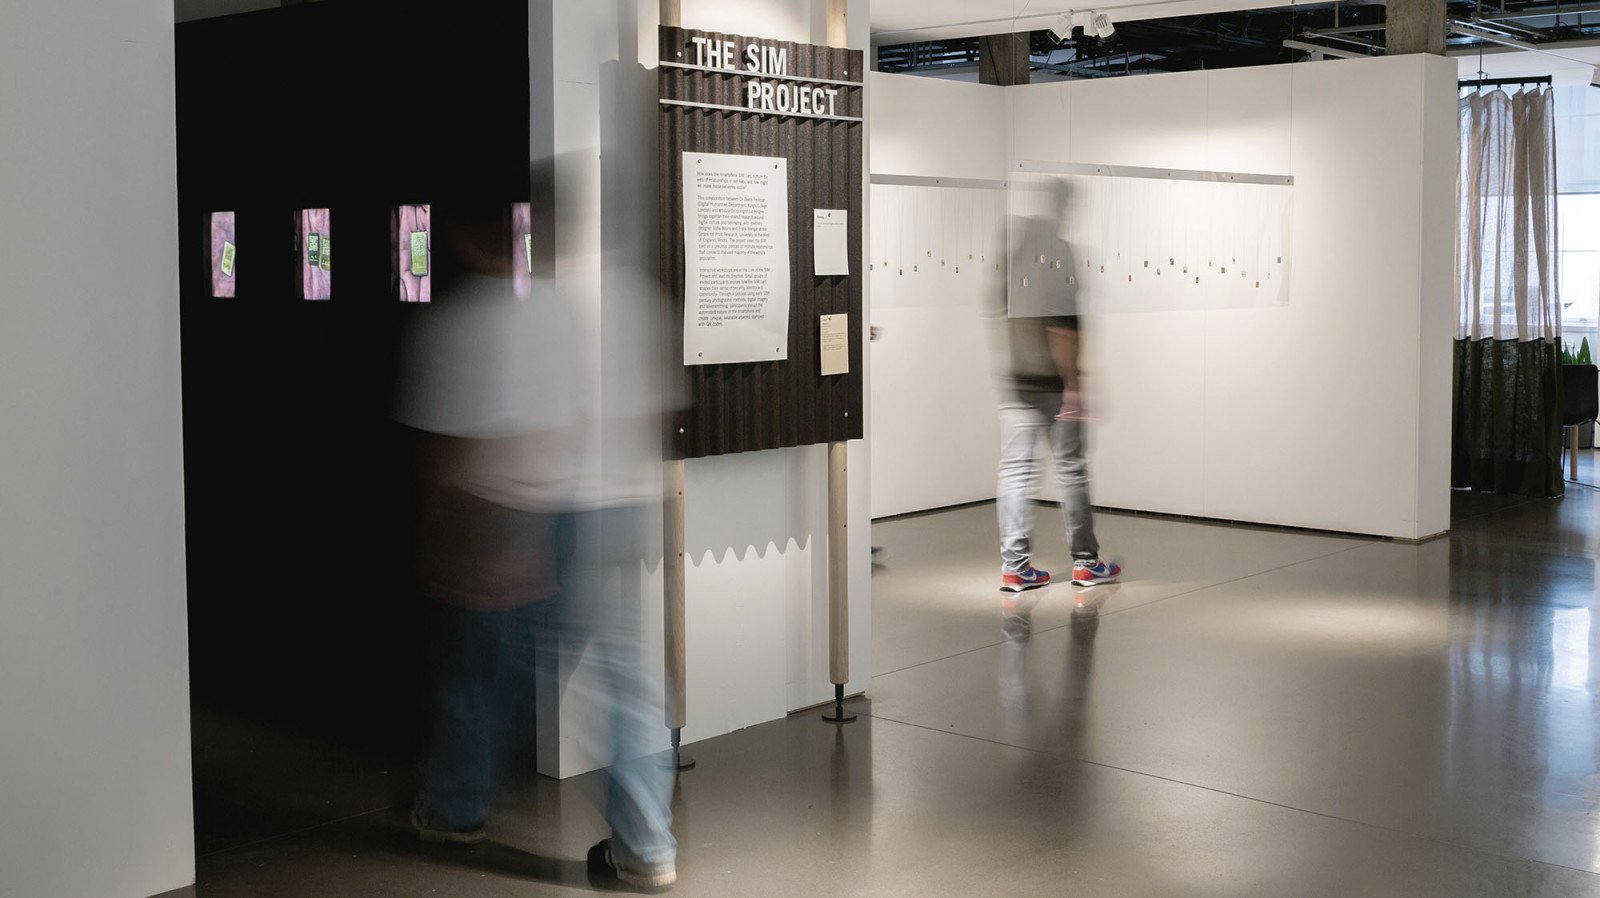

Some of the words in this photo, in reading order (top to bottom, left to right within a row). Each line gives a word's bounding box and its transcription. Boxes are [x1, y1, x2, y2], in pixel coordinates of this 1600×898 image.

[692, 37, 735, 70] THE
[747, 44, 787, 76] SIM
[748, 81, 837, 116] PROJECT
